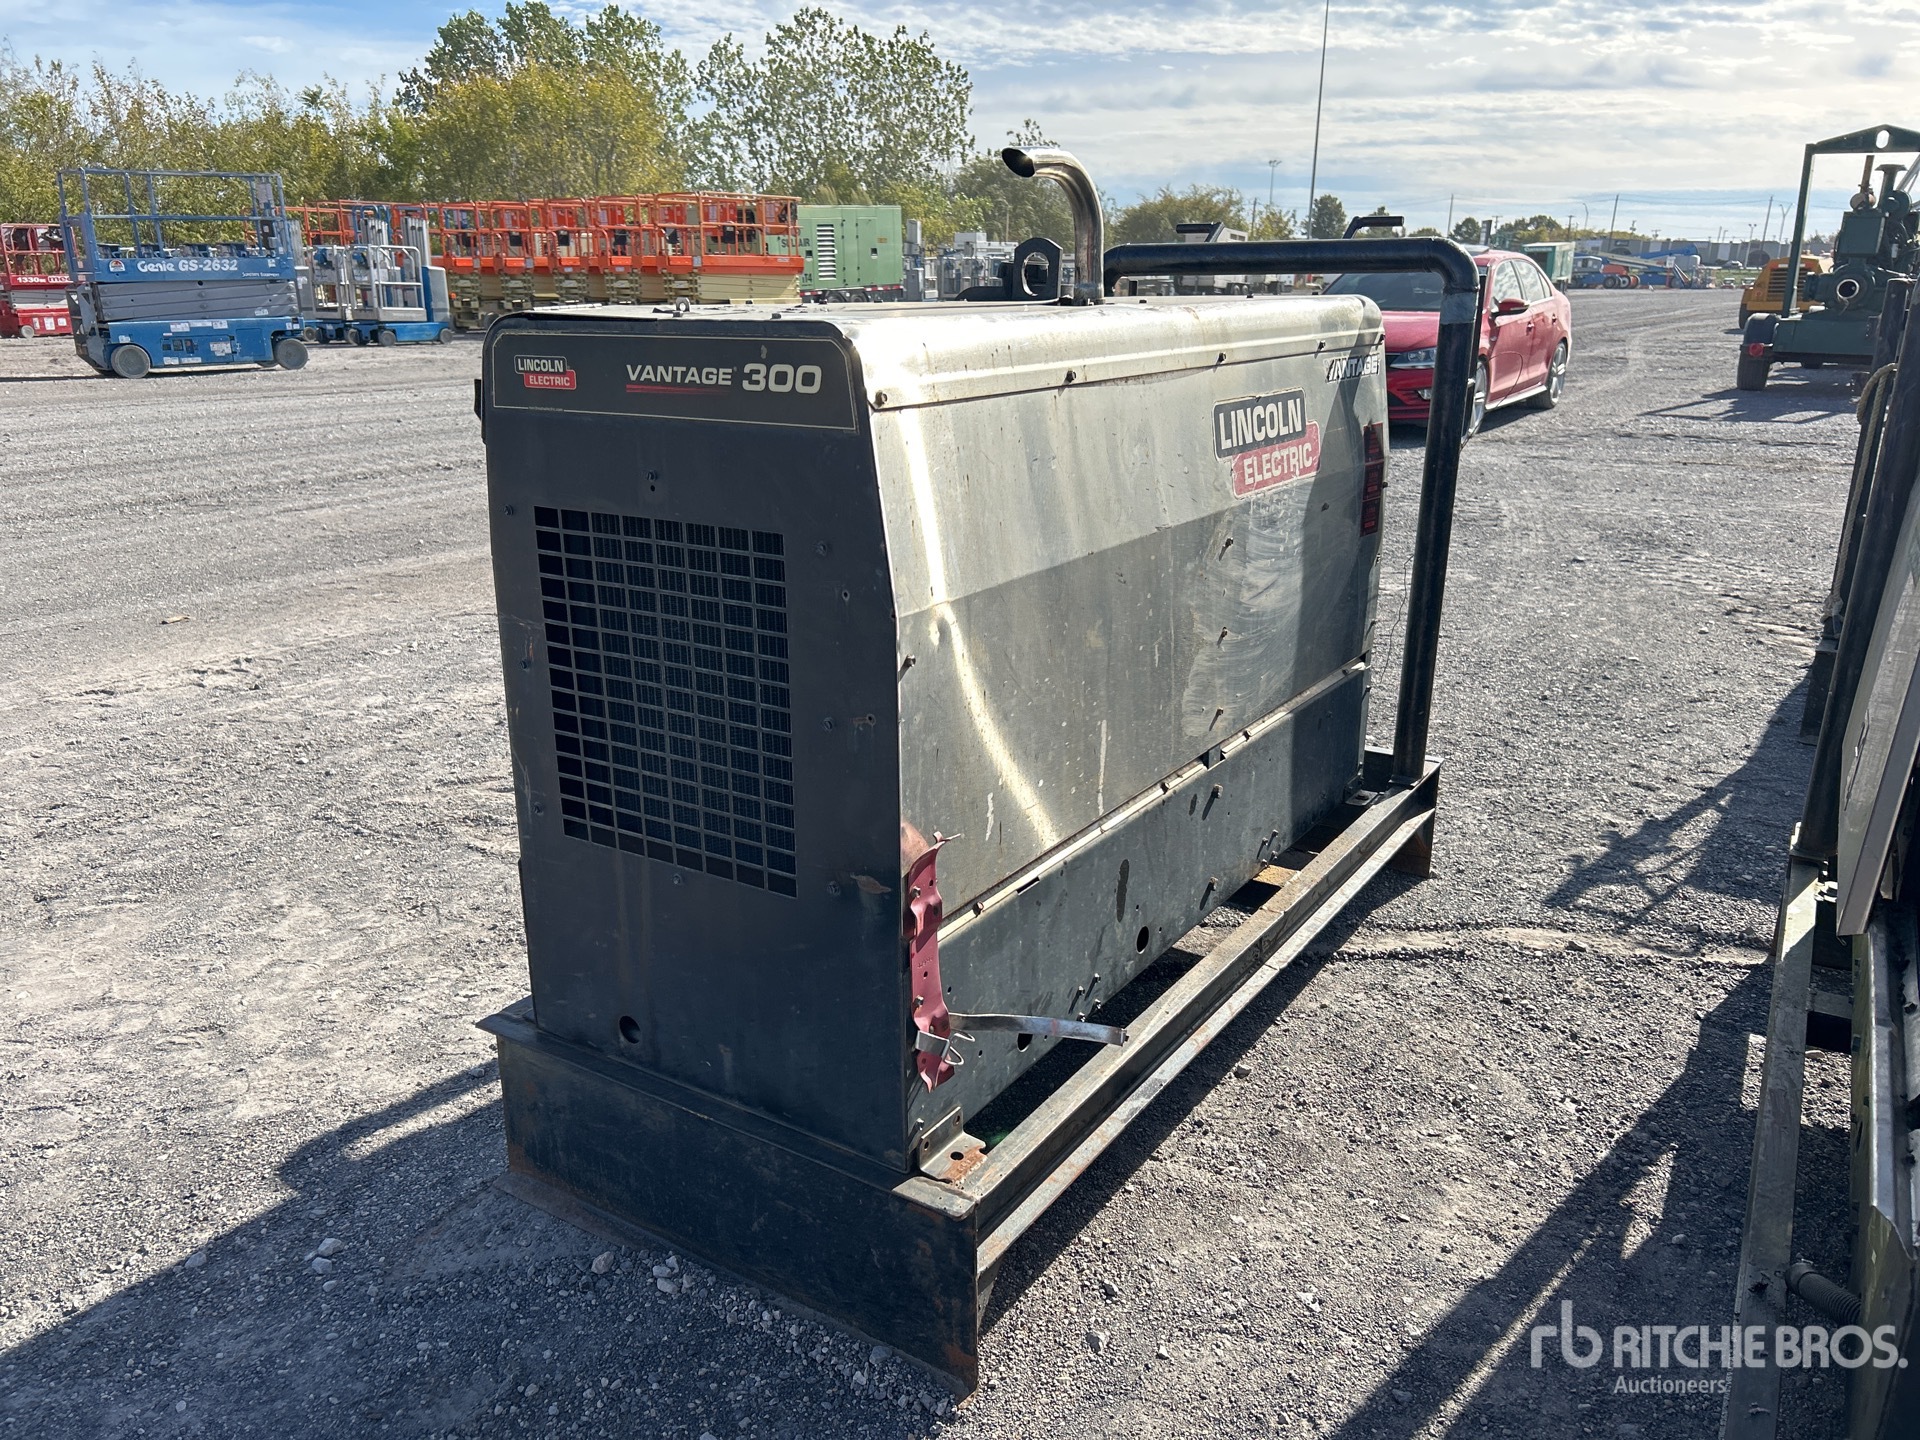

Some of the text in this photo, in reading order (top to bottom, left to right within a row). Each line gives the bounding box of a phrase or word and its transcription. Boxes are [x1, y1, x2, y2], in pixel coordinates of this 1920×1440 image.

[137, 259, 238, 273] Genie GS-2632
[517, 358, 564, 373] LINCOLN
[529, 375, 570, 387] ELECTRIC
[626, 363, 822, 394] VANTAGE 300
[1219, 398, 1302, 450] LINCOLN
[1243, 442, 1313, 485] ELECTRIC
